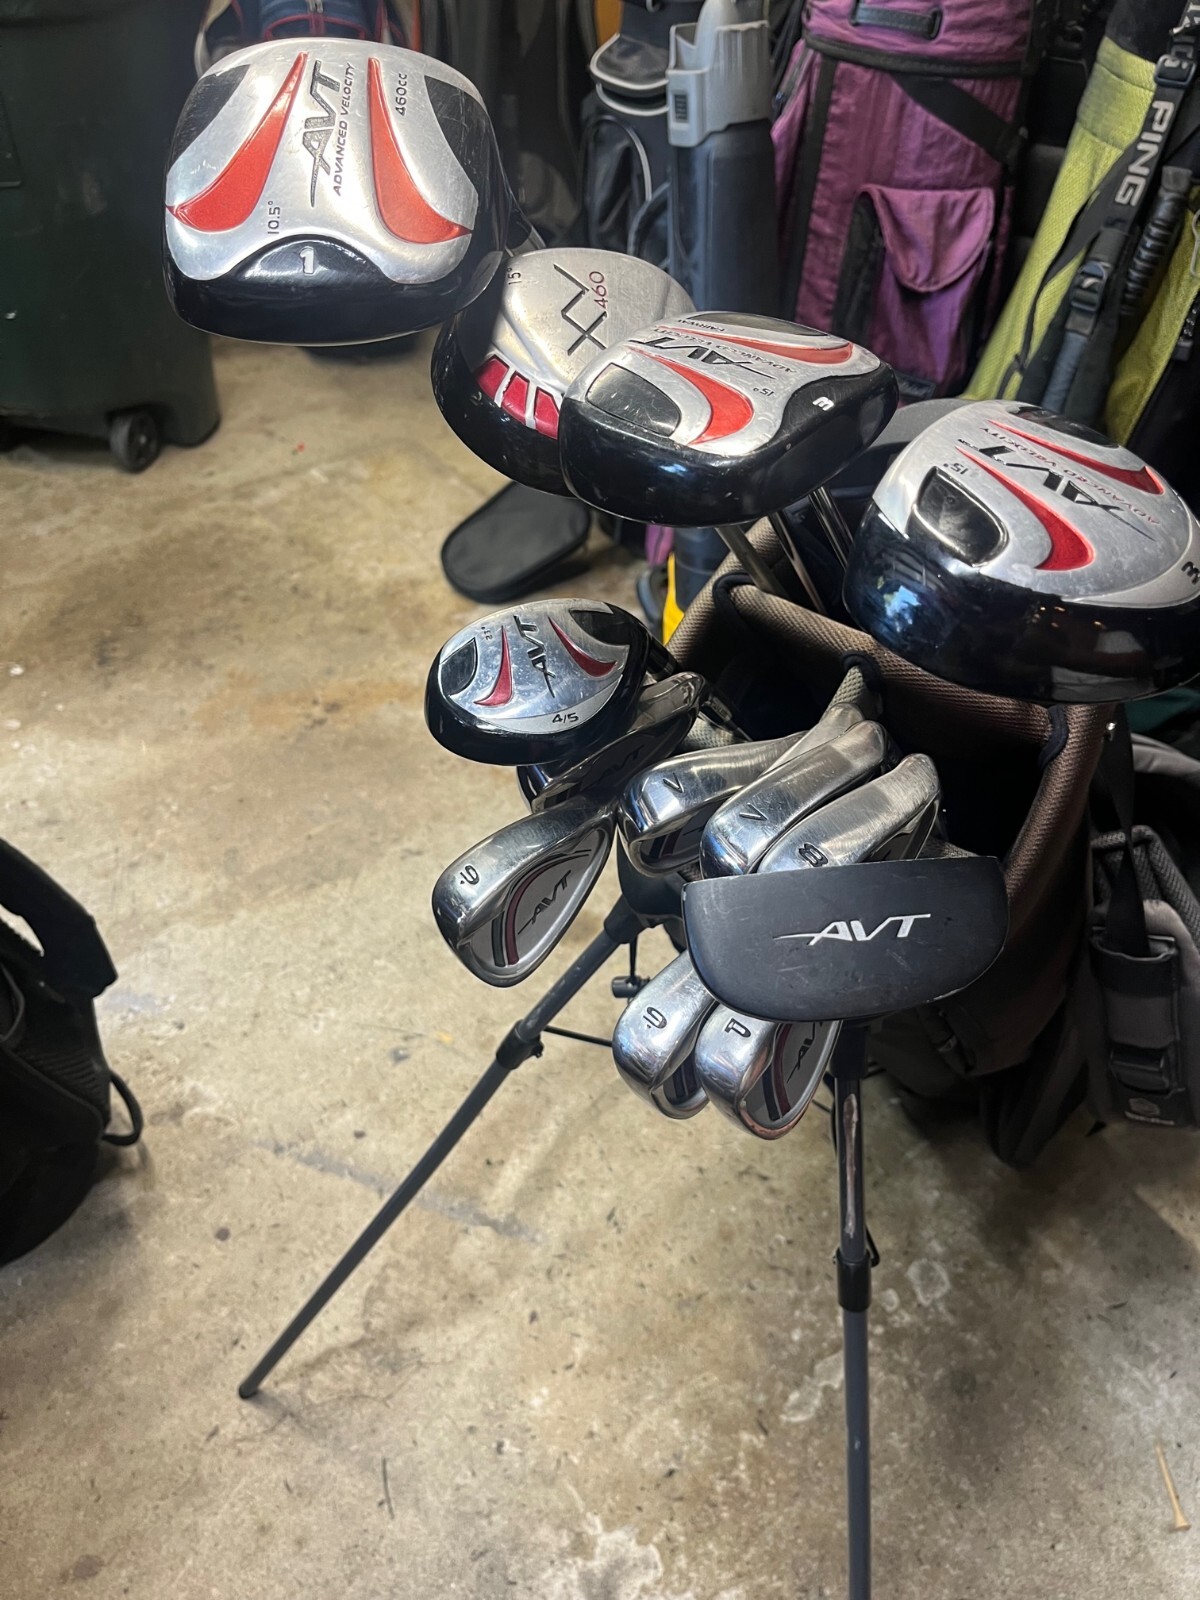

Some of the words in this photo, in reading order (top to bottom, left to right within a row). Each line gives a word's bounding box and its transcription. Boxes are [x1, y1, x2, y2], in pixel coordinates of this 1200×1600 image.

[395, 73, 408, 117] 460cc
[303, 59, 341, 207] AVT
[333, 120, 349, 196] ADVANCED
[341, 62, 355, 117] VELOCITY
[1114, 100, 1175, 207] PING
[299, 246, 315, 275] 1
[588, 271, 609, 310] 460
[628, 336, 777, 380] AVT
[715, 344, 797, 373] ADVANCED
[812, 396, 834, 412] 3
[981, 427, 1057, 468] VELOCITY
[957, 438, 1156, 542] AVT
[1062, 468, 1160, 525] ADVANCED
[513, 614, 557, 699] AVT
[551, 712, 580, 724] 4/5
[517, 869, 572, 936] AVT
[772, 913, 931, 947] AVT
[786, 1021, 823, 1085] AV
